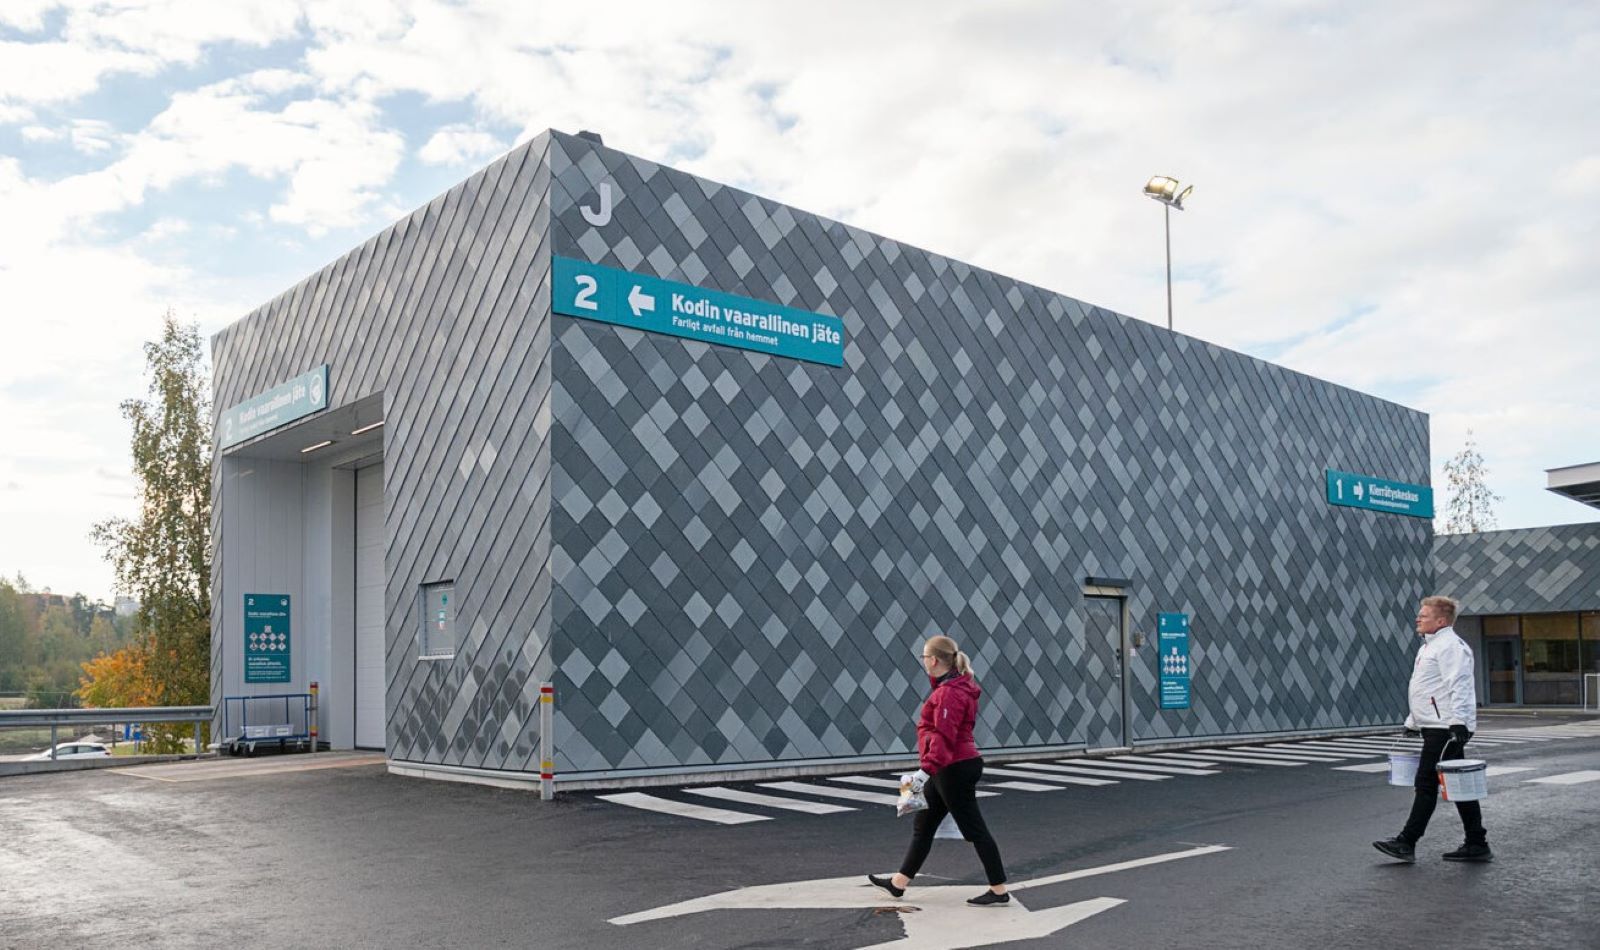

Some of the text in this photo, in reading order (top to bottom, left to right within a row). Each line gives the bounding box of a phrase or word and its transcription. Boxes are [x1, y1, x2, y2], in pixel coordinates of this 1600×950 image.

[579, 183, 612, 227] J
[574, 275, 841, 344] 2 Kodin vaarallinen jäte
[672, 316, 778, 346] Farligt avfall från hemmet
[1336, 479, 1419, 502] 1 Kierrätyskeskus
